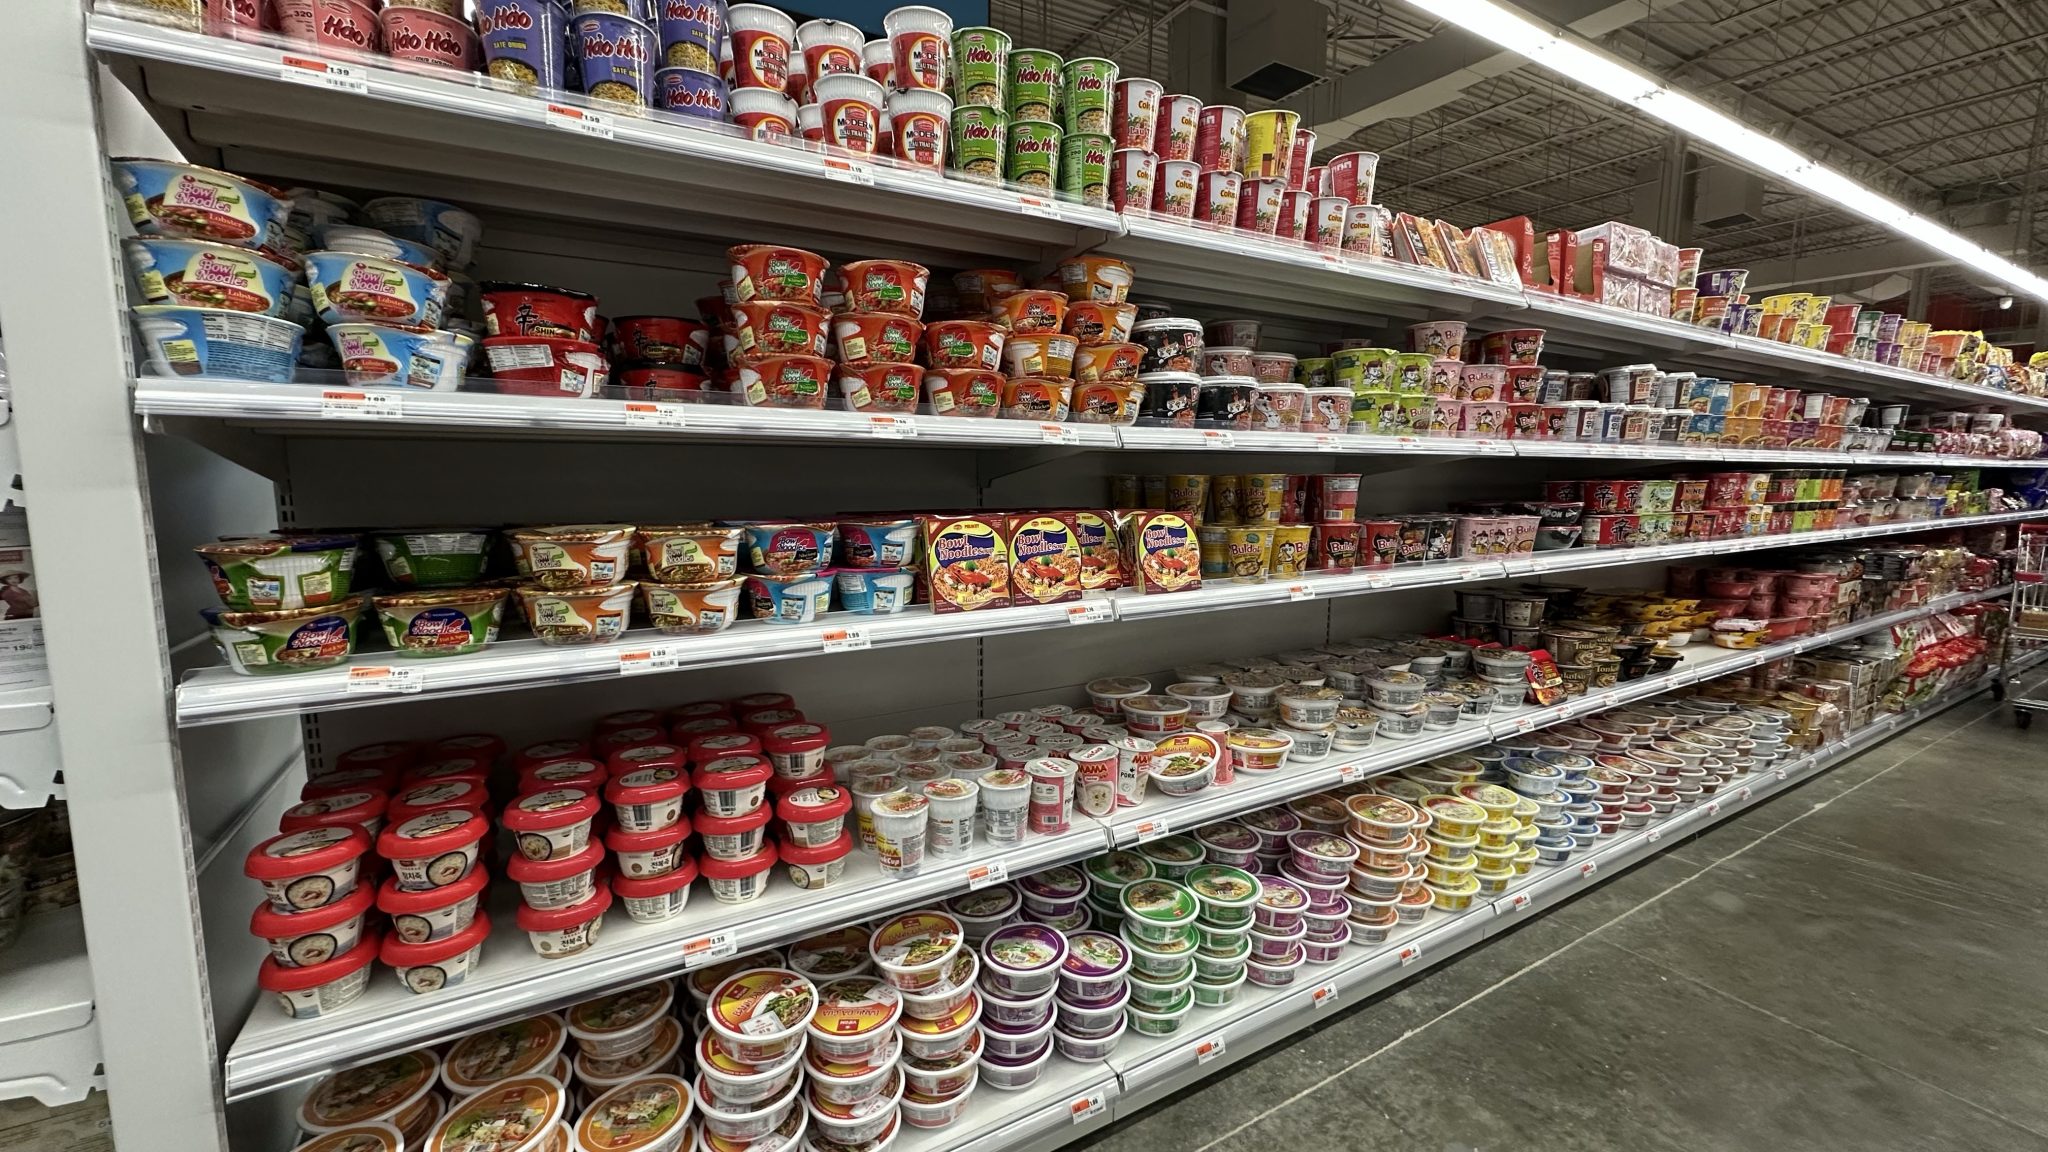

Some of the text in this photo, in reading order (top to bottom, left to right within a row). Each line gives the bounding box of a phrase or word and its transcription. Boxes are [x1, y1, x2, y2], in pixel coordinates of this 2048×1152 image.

[493, 2, 533, 30] Hảo
[323, 15, 365, 46] Hảo
[391, 27, 462, 57] Hảo Hảo
[583, 33, 615, 60] Hảo
[966, 45, 992, 63] Hảo
[329, 67, 349, 76] 1.39
[1016, 66, 1041, 84] Hảo
[665, 85, 695, 108] Hảo
[837, 118, 873, 130] MODERN
[964, 122, 989, 140] Hảo
[1015, 135, 1040, 154] Hảo
[179, 182, 217, 199] Bowl
[175, 192, 232, 212] Noodles
[209, 214, 243, 228] Lobster
[199, 259, 236, 276] Bowl
[195, 270, 249, 287] Noodles
[353, 269, 385, 285] Bowl
[350, 278, 396, 295] Noodles
[228, 289, 259, 301] Lobster
[377, 298, 405, 308] Lobster
[516, 303, 538, 336] 辛
[535, 326, 555, 335] SHIN
[1540, 508, 1562, 518] UDON
[1145, 527, 1168, 540] Bowl
[1611, 518, 1633, 542] 辛
[779, 536, 800, 546] Bowl
[938, 534, 969, 549] Bowl
[1017, 530, 1044, 546] Bowl
[1146, 535, 1175, 549] Noodle
[777, 543, 807, 551] Noodles
[939, 545, 978, 560] Noodle
[1018, 541, 1052, 556] Noodle
[411, 625, 462, 635] Noodles
[414, 618, 447, 630] Bowl
[292, 635, 343, 648] Noodles
[297, 628, 333, 640] Bowl
[1079, 763, 1108, 775] MAMA
[1121, 771, 1135, 779] PORK
